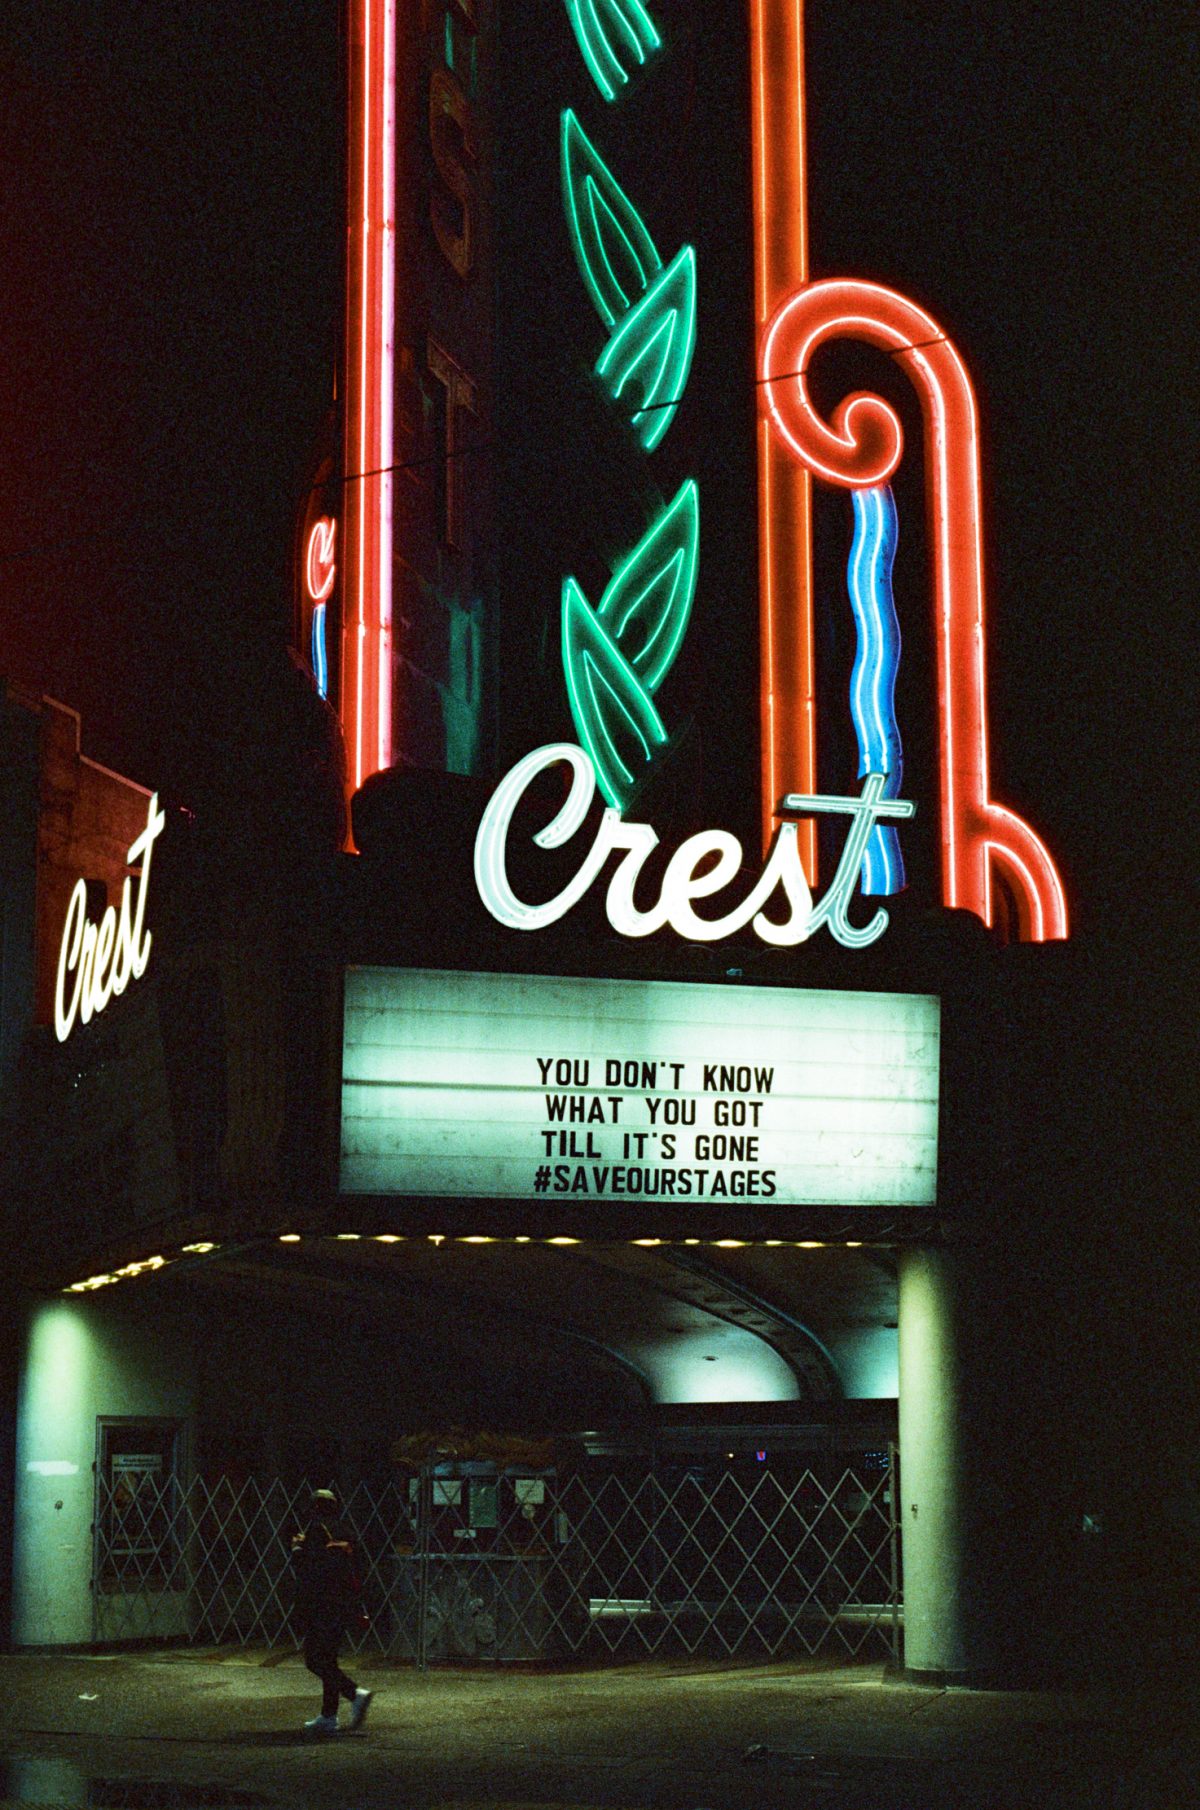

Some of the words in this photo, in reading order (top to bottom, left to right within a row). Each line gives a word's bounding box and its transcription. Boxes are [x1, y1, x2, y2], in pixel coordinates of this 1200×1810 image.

[473, 742, 916, 949] Crest
[54, 792, 166, 1044] Crest
[536, 1057, 590, 1087] YOU
[605, 1059, 685, 1090] DON'T
[703, 1064, 775, 1094] KNOW
[545, 1094, 624, 1124] WHAT
[645, 1097, 696, 1126] YOU
[714, 1100, 764, 1128] GOT
[541, 1130, 602, 1159] TILL
[623, 1132, 676, 1160] IT'S
[695, 1134, 759, 1162] GONE
[533, 1165, 777, 1197] #SAVEOURSTAGES
